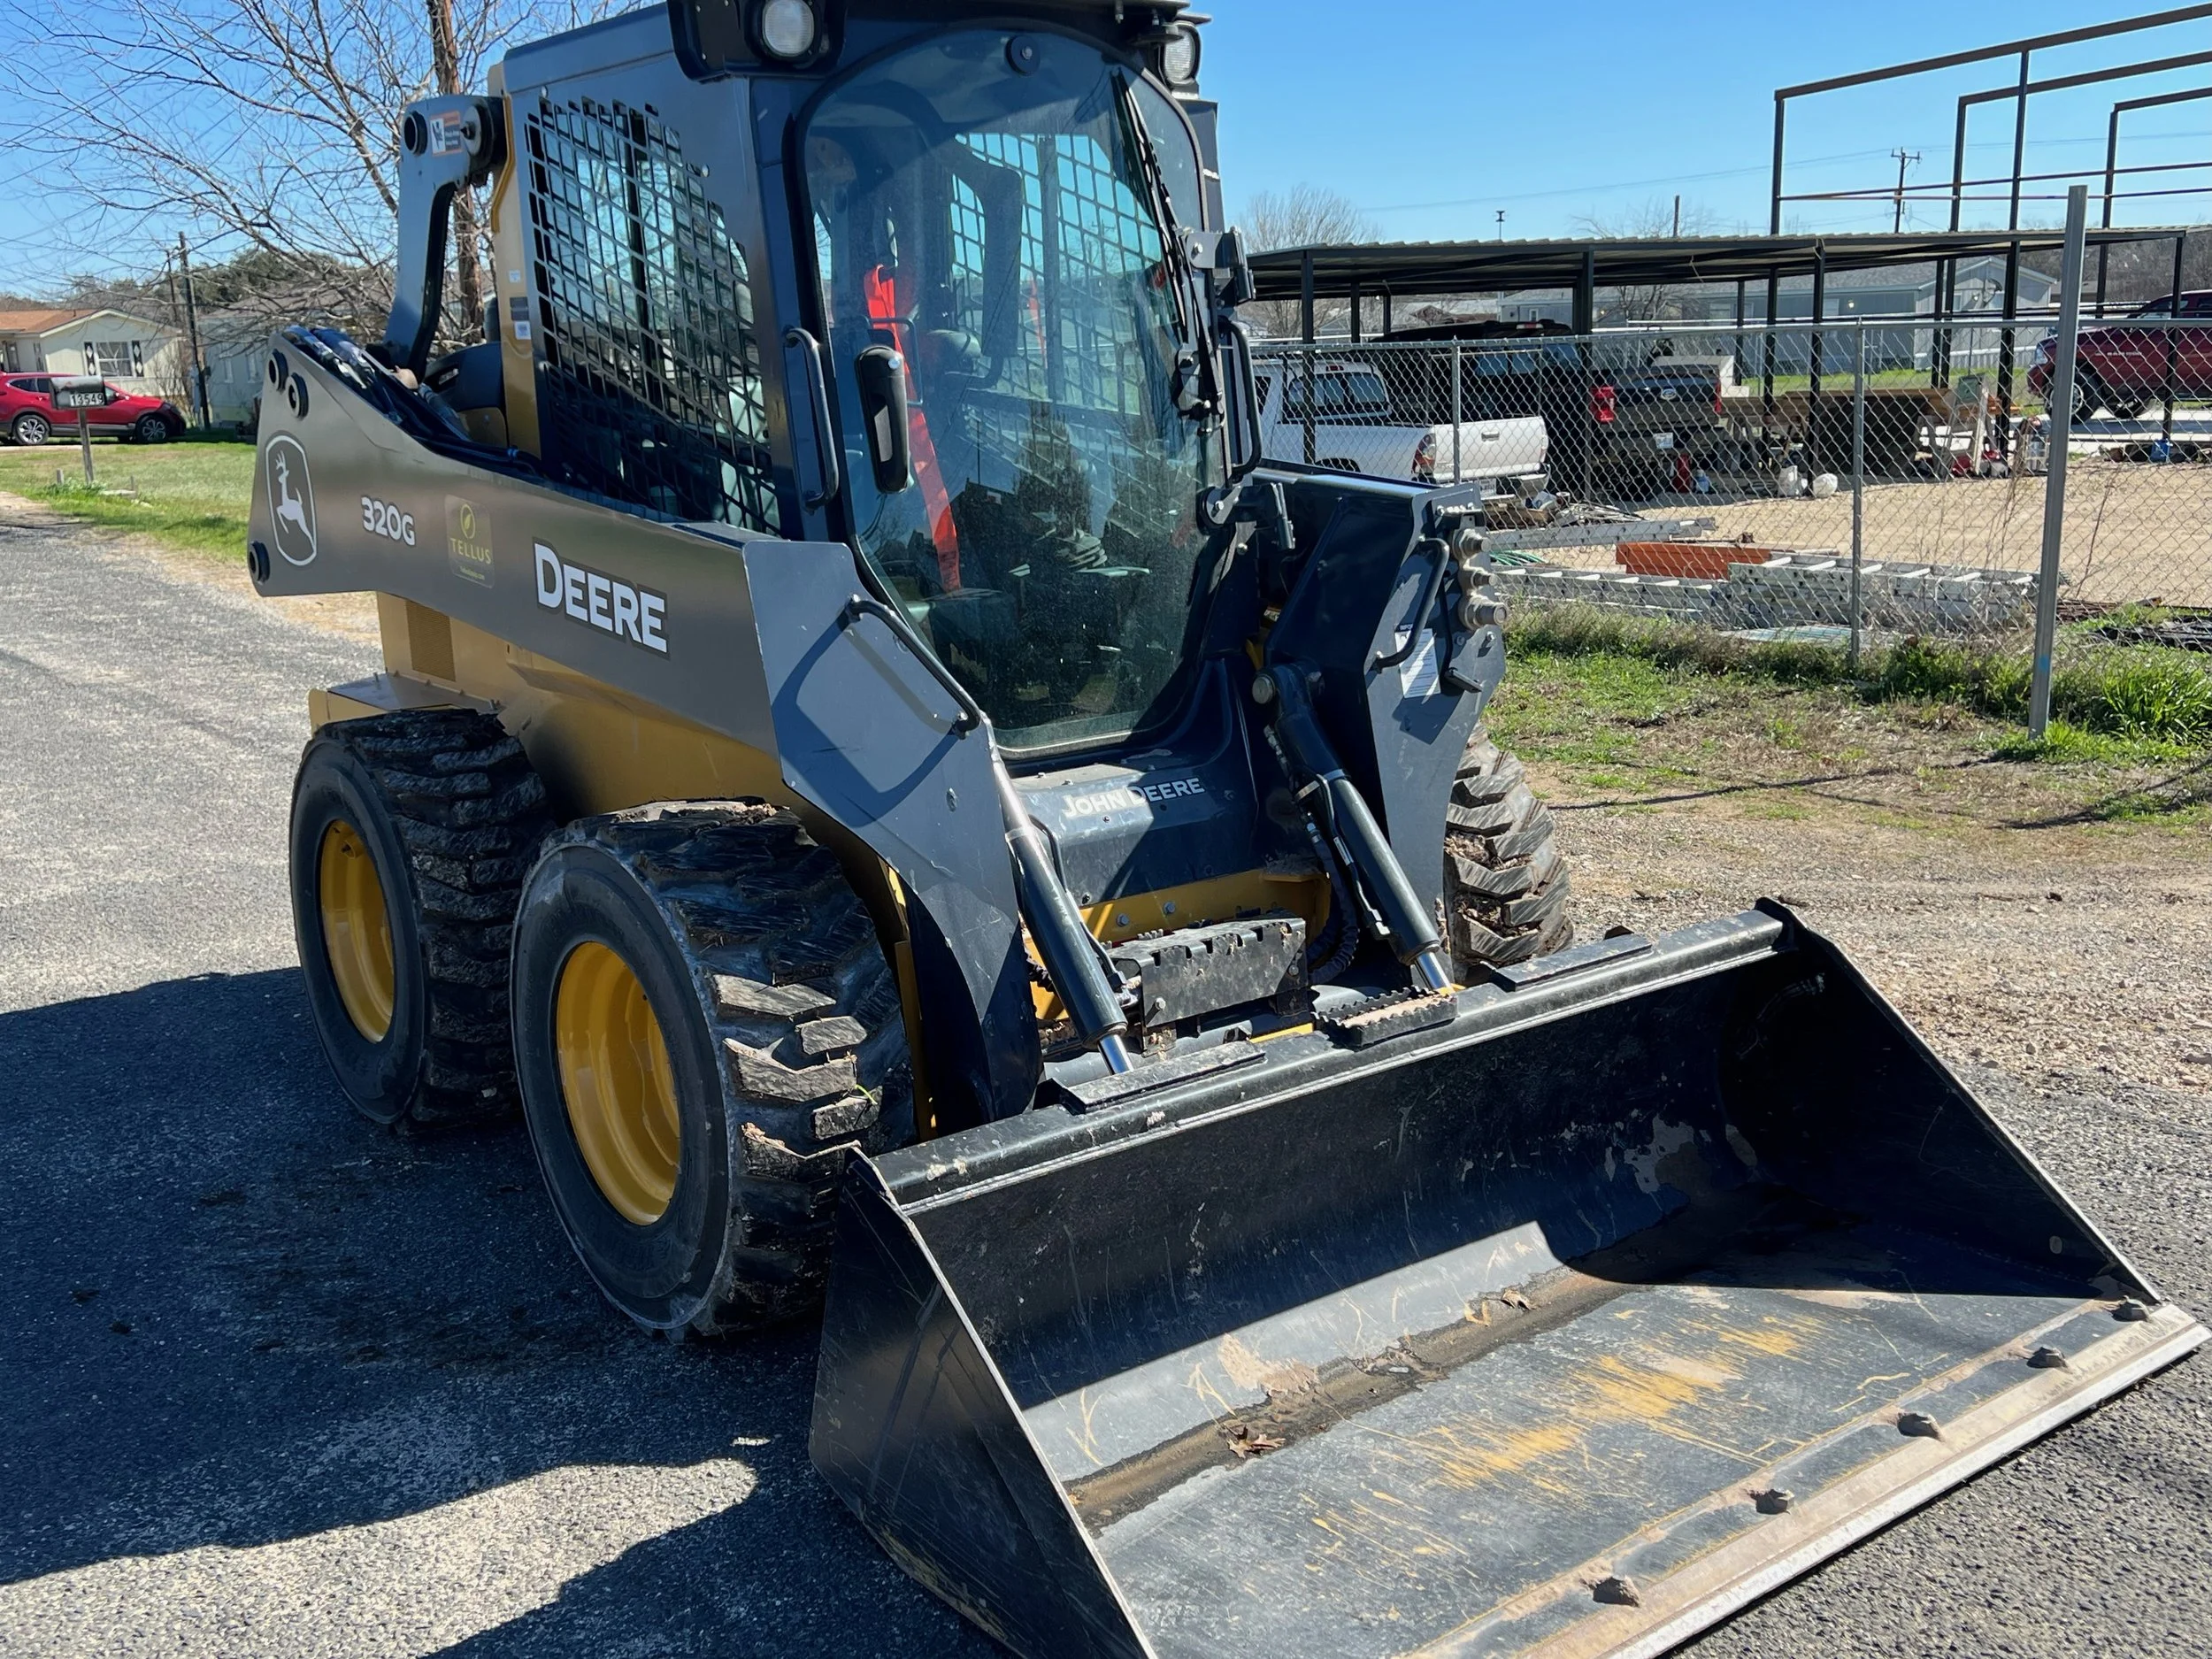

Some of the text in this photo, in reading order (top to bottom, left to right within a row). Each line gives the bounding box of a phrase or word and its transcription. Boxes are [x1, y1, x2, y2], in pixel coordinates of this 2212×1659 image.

[72, 393, 104, 405] 13549
[361, 496, 416, 546] 320G
[449, 537, 492, 565] TELLUS
[534, 542, 667, 653] DEERE
[1062, 778, 1206, 818] JOHN DEERE
